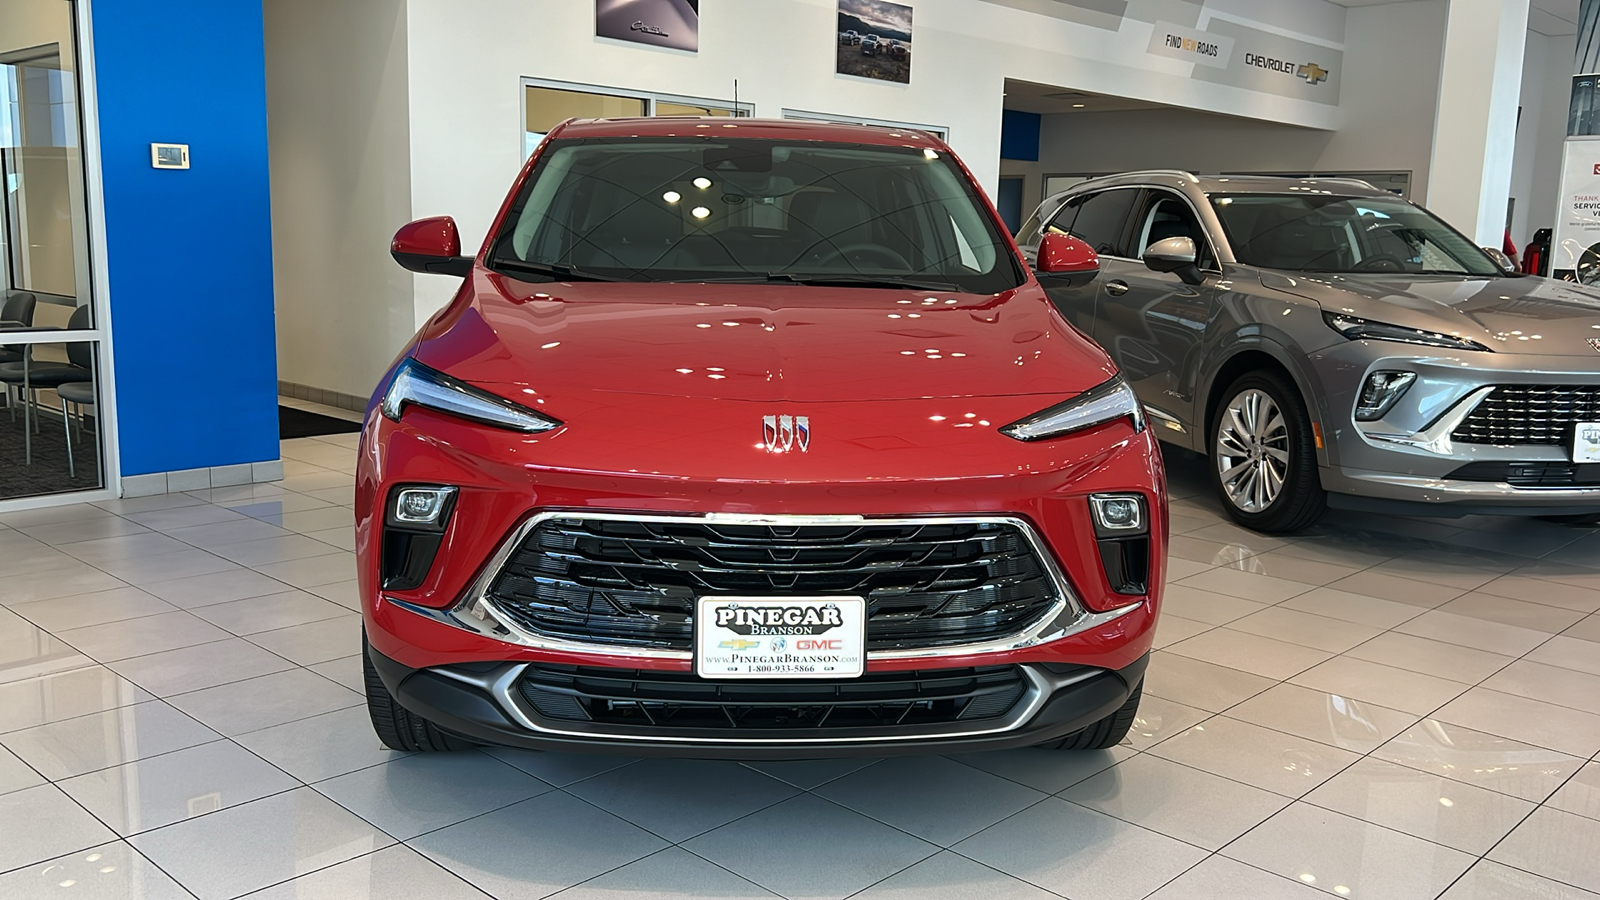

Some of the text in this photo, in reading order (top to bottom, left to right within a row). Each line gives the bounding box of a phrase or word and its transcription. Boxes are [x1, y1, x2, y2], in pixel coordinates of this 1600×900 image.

[1165, 34, 1218, 57] FIND NEW ROADS
[1245, 52, 1295, 75] CHEVROLET
[717, 608, 841, 626] PINEGAR
[750, 624, 813, 635] BRANSON
[796, 639, 843, 651] GMC
[748, 665, 815, 673] 1-800-933-5866
